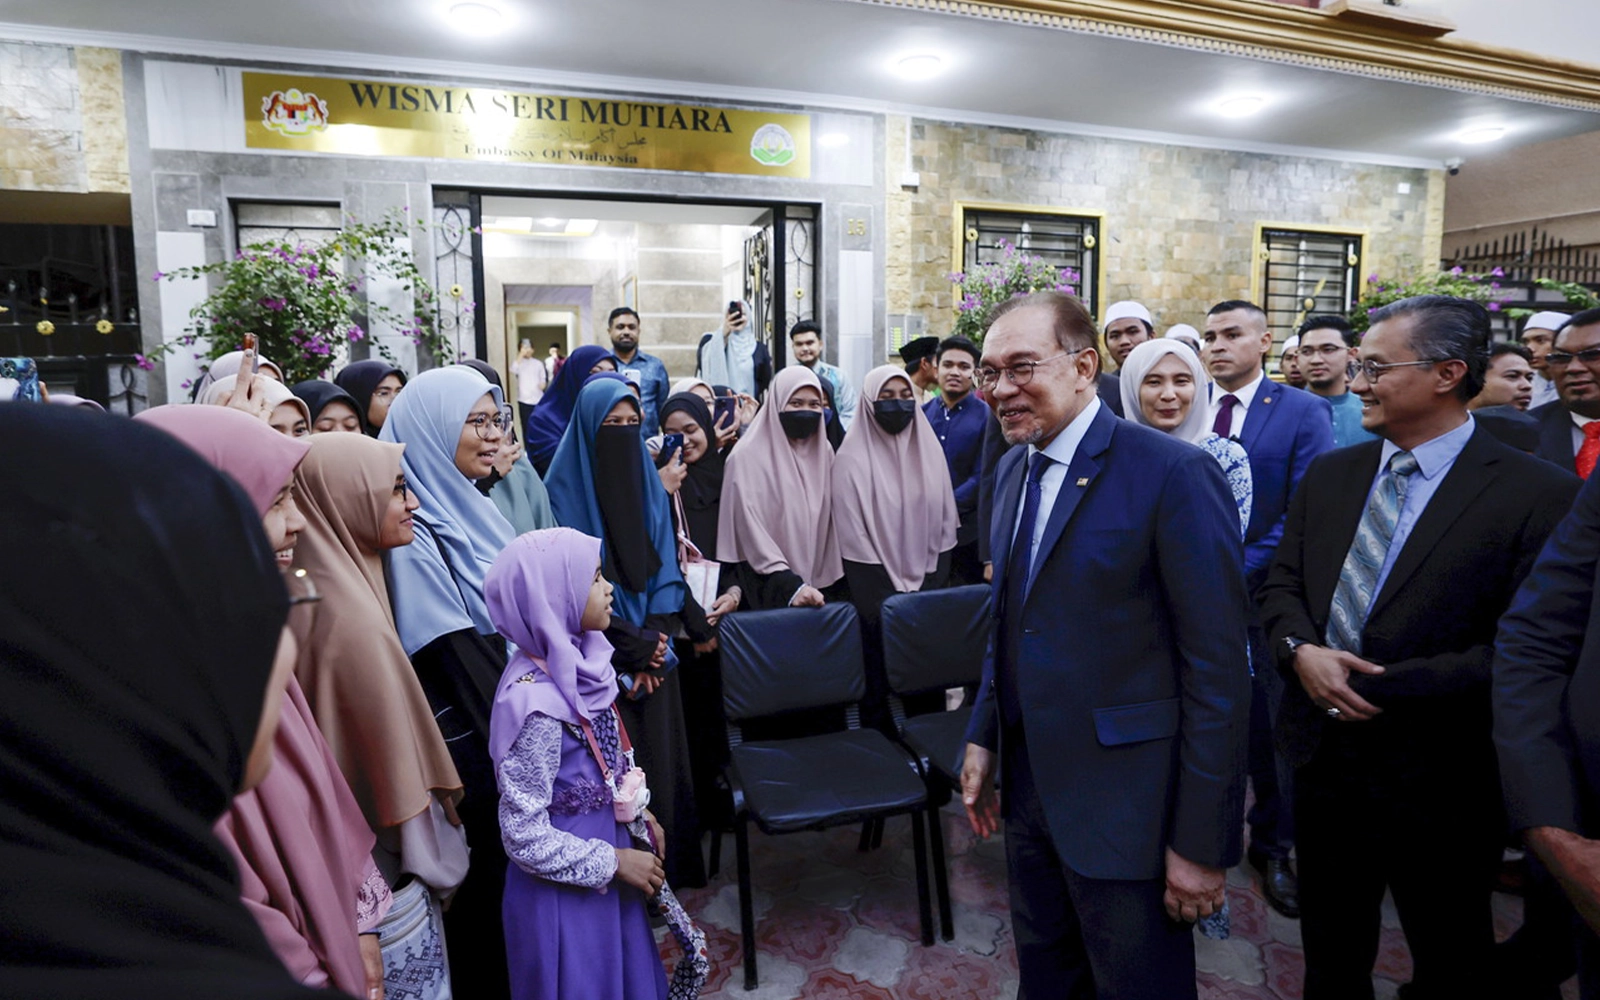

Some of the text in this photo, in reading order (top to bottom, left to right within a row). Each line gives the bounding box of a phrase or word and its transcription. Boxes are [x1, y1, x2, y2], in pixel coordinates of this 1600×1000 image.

[348, 83, 476, 114] WISMA
[493, 94, 569, 122] SERI
[580, 101, 732, 133] MUTIARA
[464, 144, 638, 165] Embassy Of Malaysia
[847, 218, 866, 236] 15
